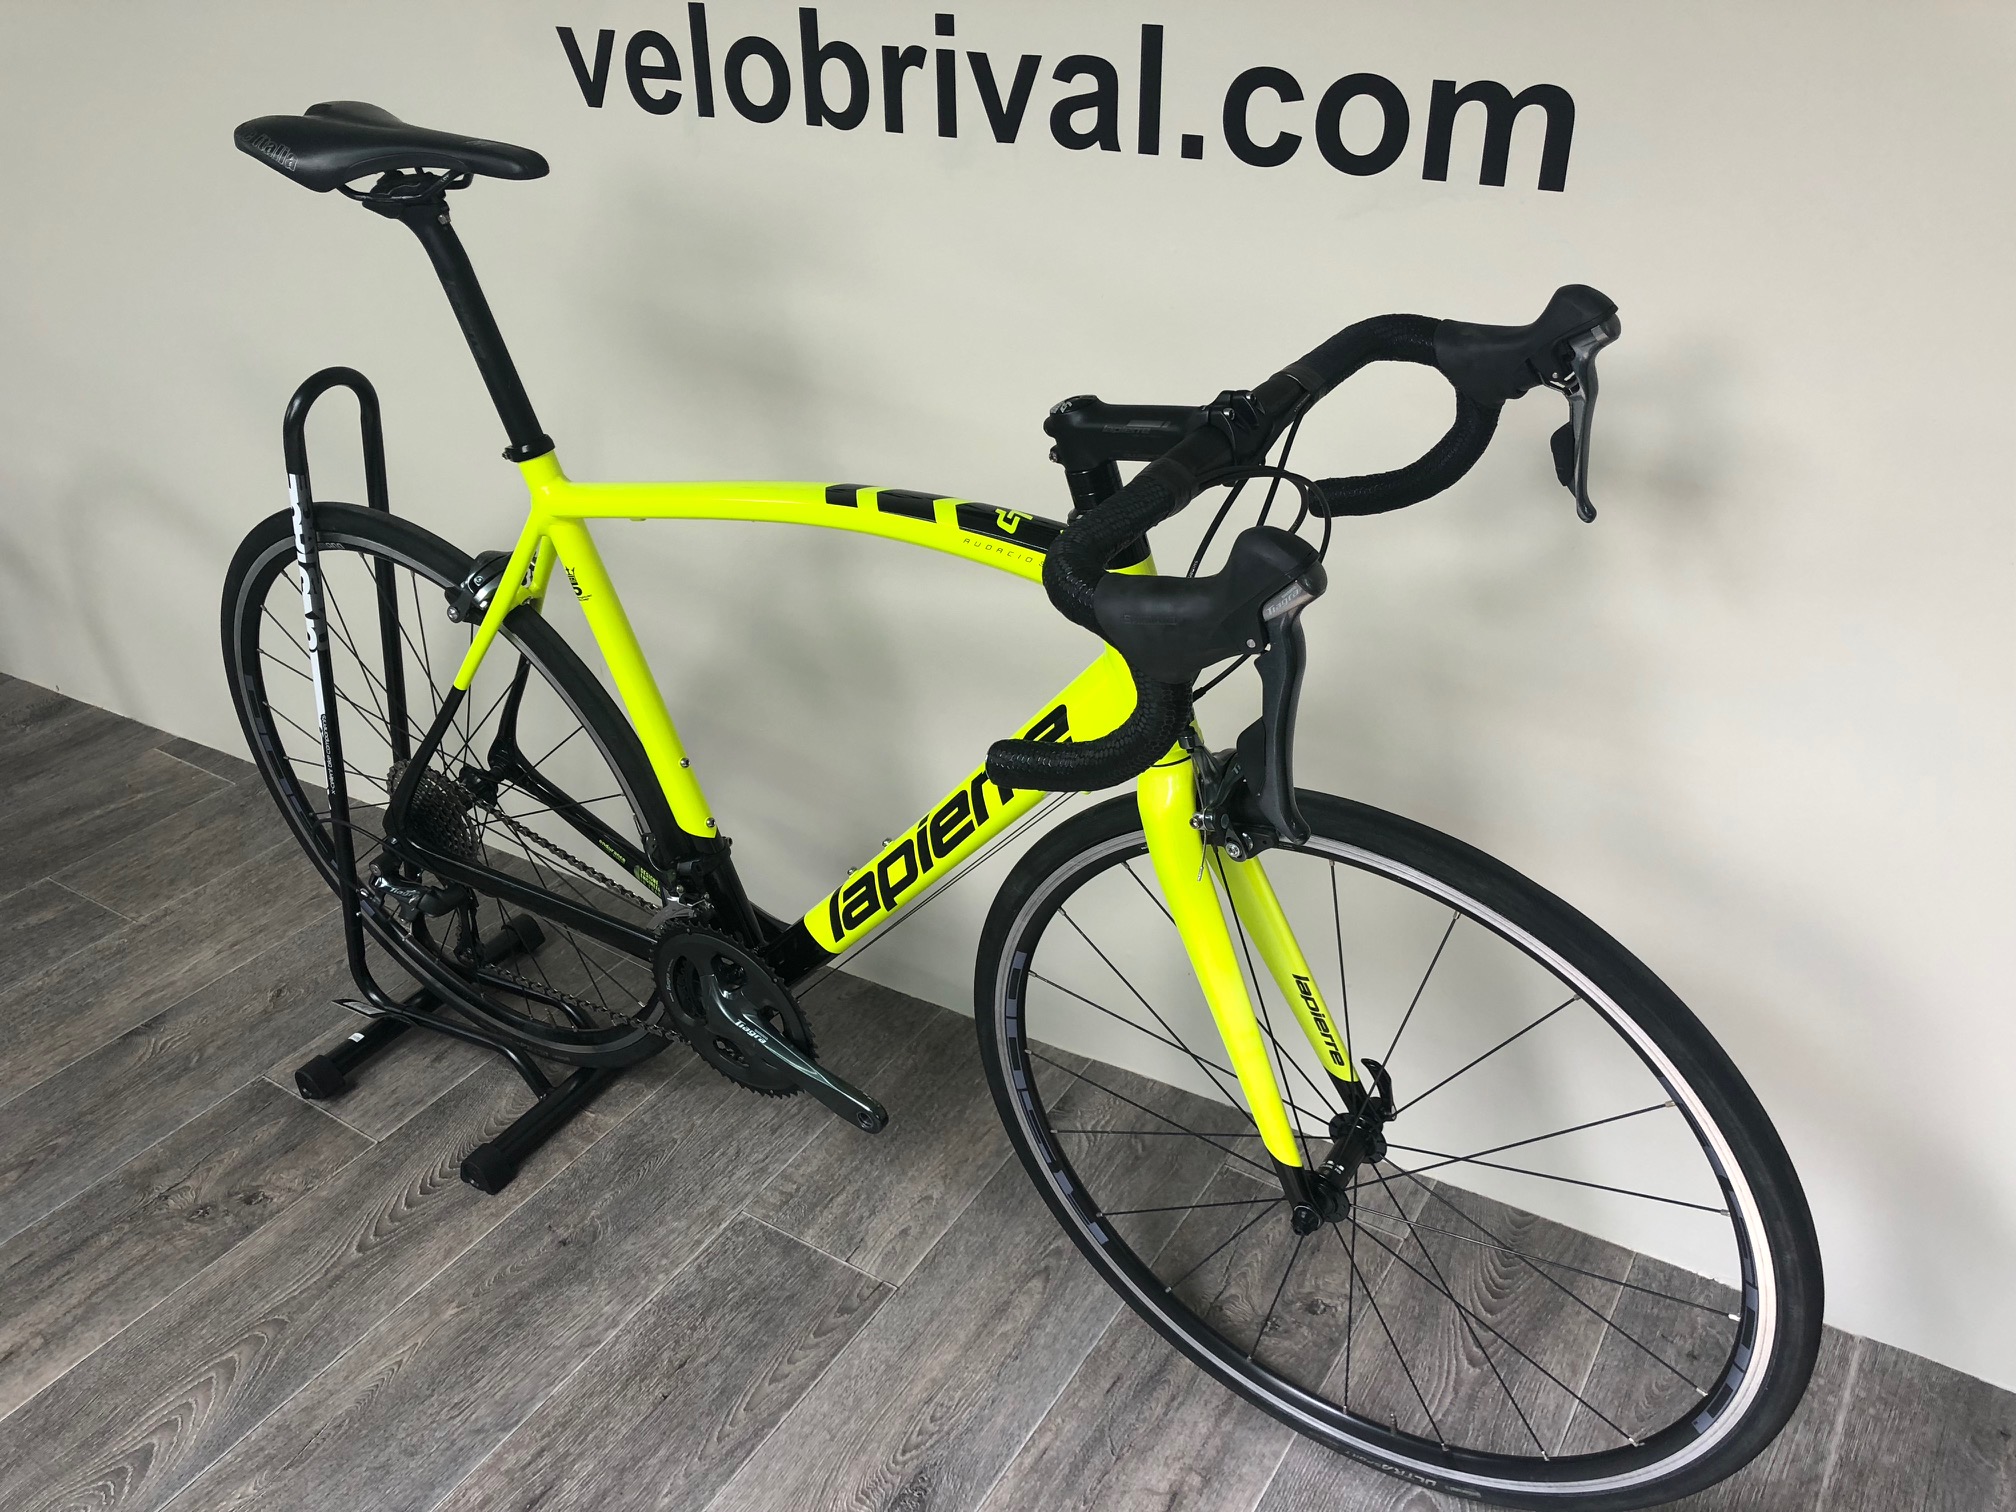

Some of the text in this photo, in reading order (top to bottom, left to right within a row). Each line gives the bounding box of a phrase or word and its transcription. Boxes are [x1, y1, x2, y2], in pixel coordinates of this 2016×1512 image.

[556, 2, 1575, 192] velobrival.com
[1265, 589, 1300, 616] Tiagra
[735, 1019, 769, 1044] Tiagra
[1292, 973, 1345, 1067] lapierre
